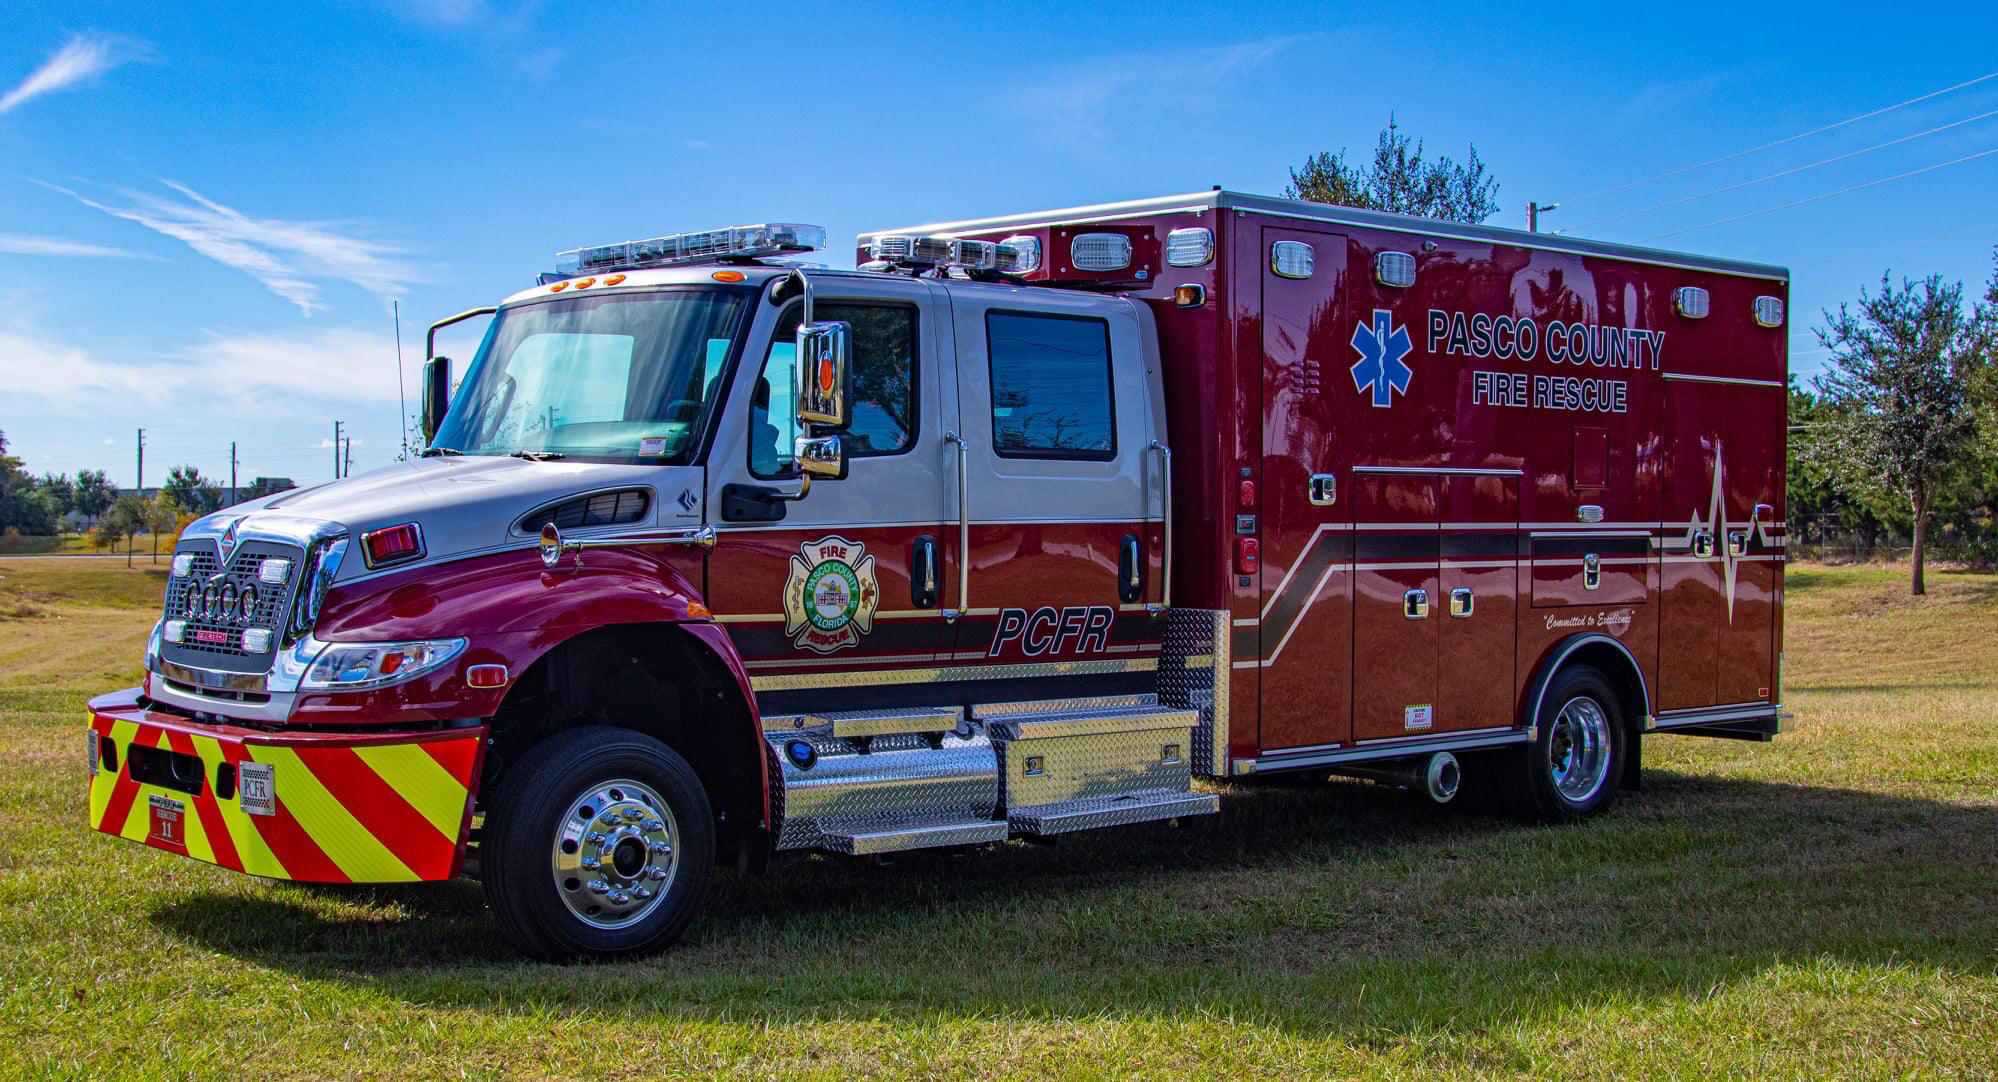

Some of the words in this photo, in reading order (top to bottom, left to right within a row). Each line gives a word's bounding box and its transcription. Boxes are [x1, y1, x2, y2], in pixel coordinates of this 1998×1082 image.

[1428, 309, 1538, 361] PASCO
[1546, 320, 1665, 370] COUNTY
[1473, 371, 1527, 407] FIRE
[1534, 376, 1627, 413] RESCUE
[819, 545, 847, 559] FIRE
[807, 564, 831, 591] PASCO
[832, 564, 858, 591] COUNTY
[813, 614, 848, 628] FLORIDA
[1587, 615, 1595, 626] to
[807, 629, 849, 645] RESCUE
[989, 606, 1114, 656] PCFR
[244, 779, 266, 798] PCFR
[162, 820, 173, 838] 11
